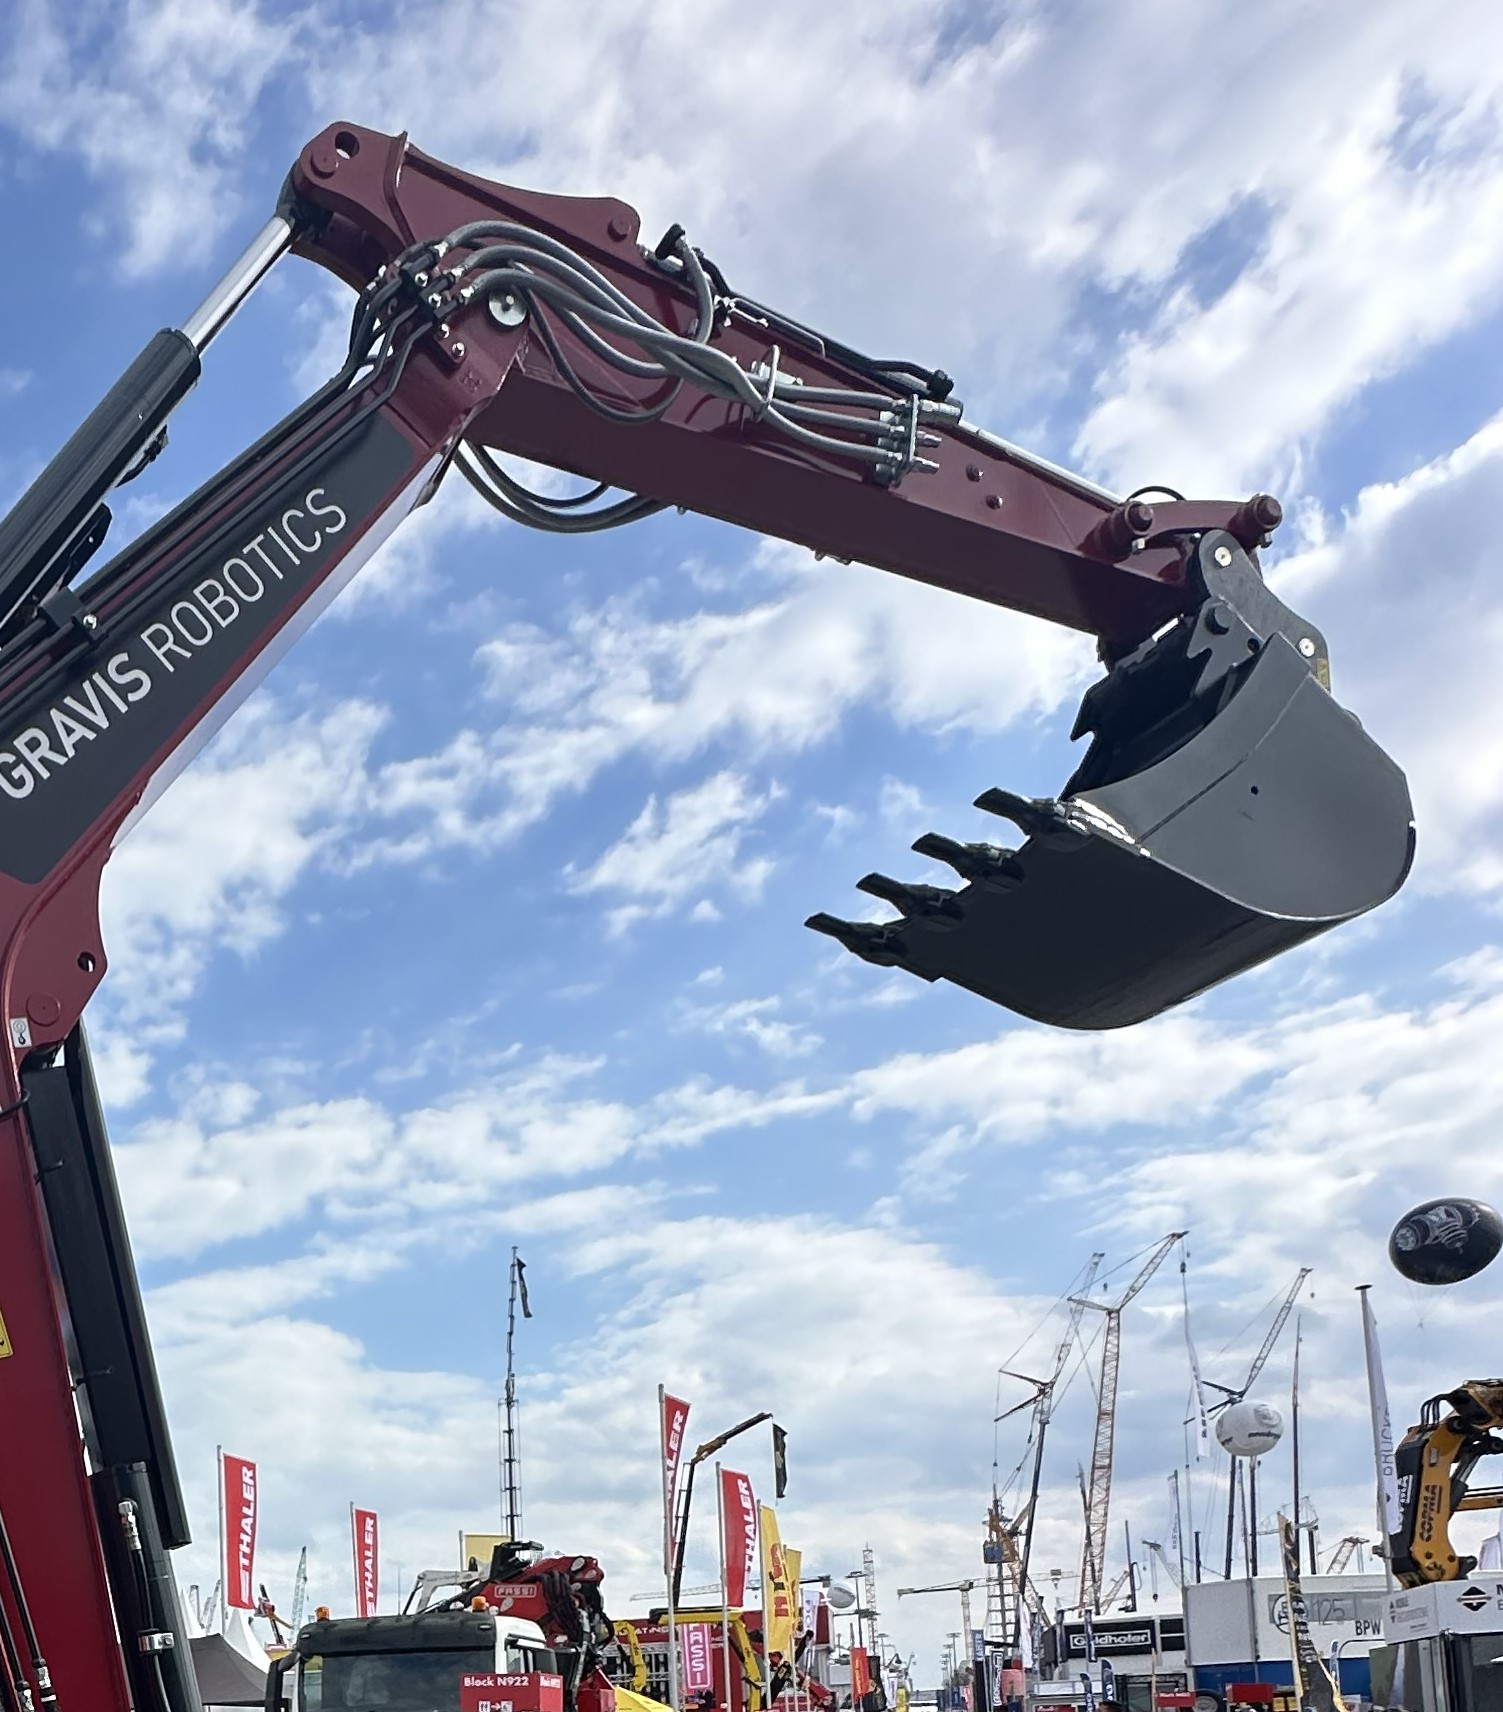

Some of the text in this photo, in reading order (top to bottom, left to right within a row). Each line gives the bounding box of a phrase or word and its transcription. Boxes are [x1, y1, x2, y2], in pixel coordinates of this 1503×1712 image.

[140, 488, 347, 673] ROBOTICS
[497, 1585, 535, 1597] FASSI
[1354, 1620, 1381, 1636] BPW
[1073, 1632, 1148, 1647] Gldhofer
[463, 1676, 494, 1687] Block
[497, 1676, 529, 1687] N922
